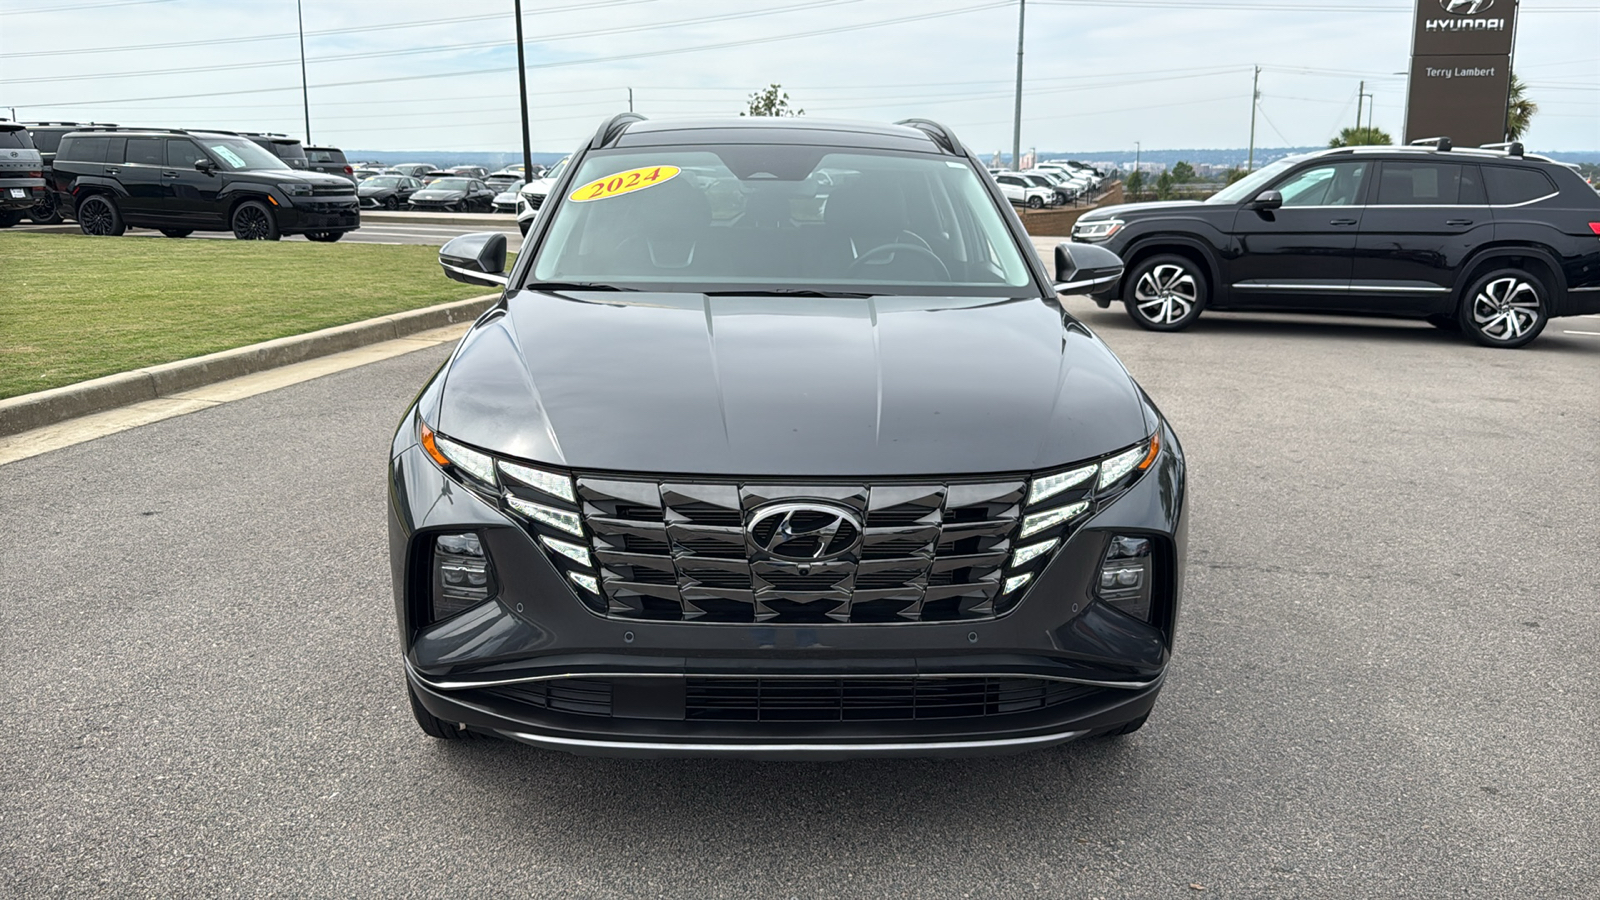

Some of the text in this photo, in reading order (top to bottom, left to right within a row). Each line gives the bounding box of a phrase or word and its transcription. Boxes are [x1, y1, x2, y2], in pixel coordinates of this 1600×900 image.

[1425, 18, 1505, 31] HYUNDAI
[1426, 67, 1495, 79] Terry Lambert
[588, 167, 662, 199] 2024
